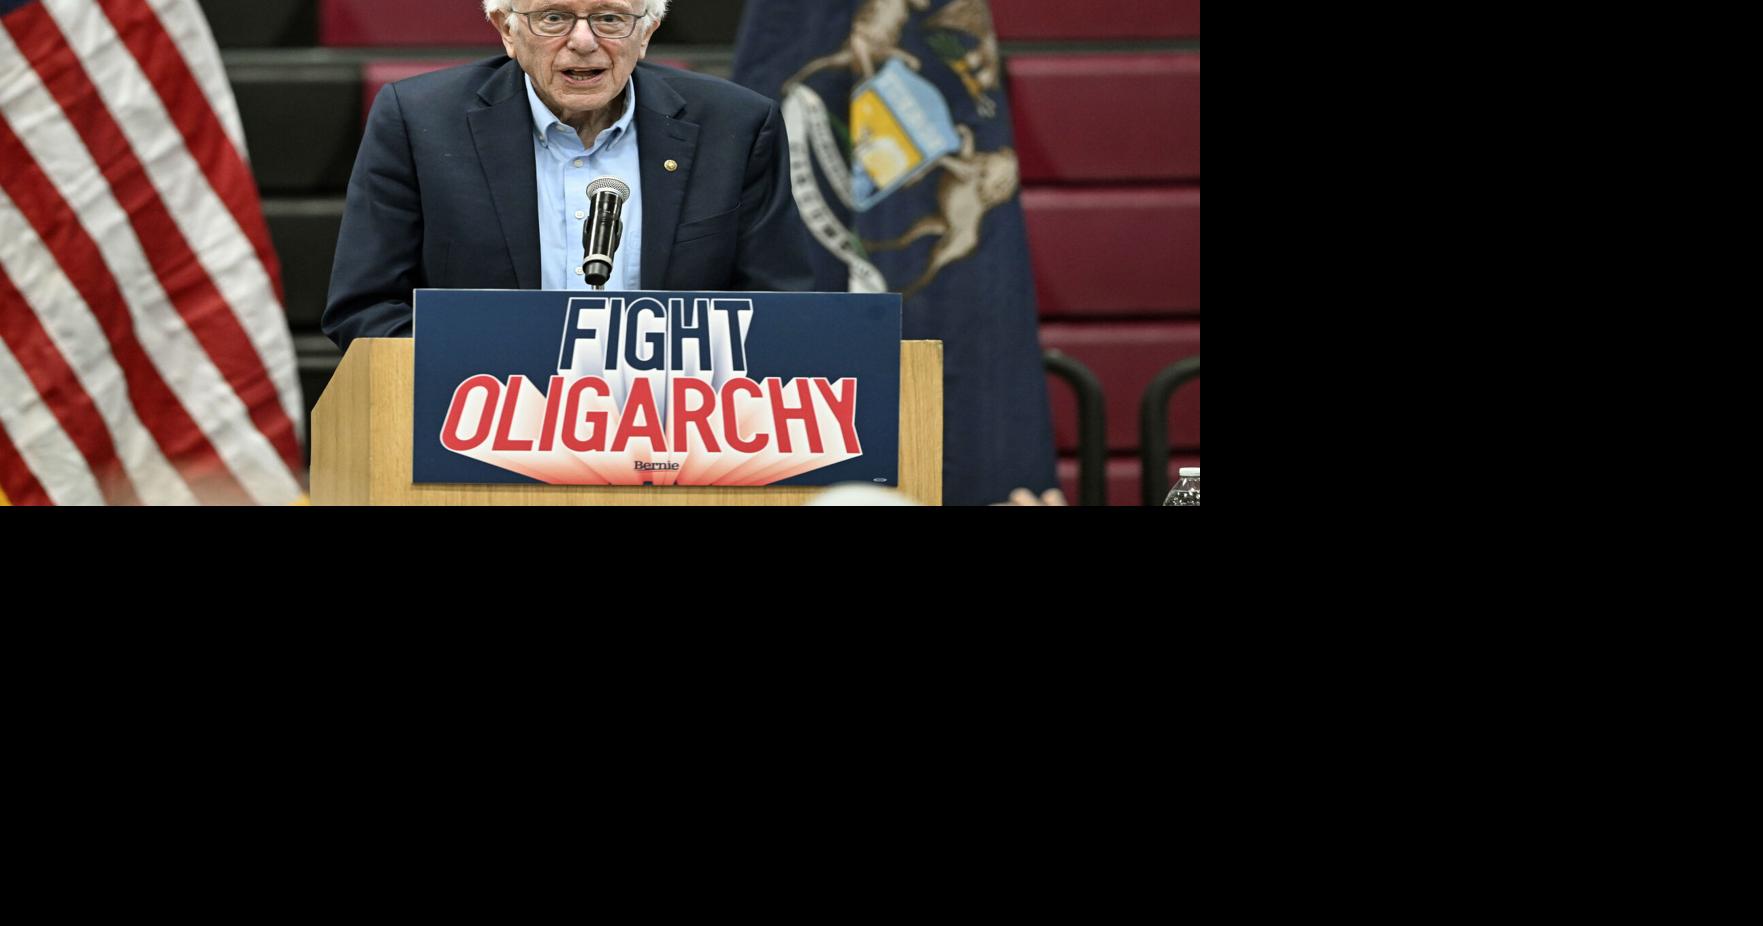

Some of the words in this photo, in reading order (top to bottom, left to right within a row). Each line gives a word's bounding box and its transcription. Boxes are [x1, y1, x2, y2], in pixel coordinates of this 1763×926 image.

[558, 297, 752, 373] FIGHT
[441, 375, 863, 454] OLIGARCHY
[633, 460, 680, 471] Bernie
